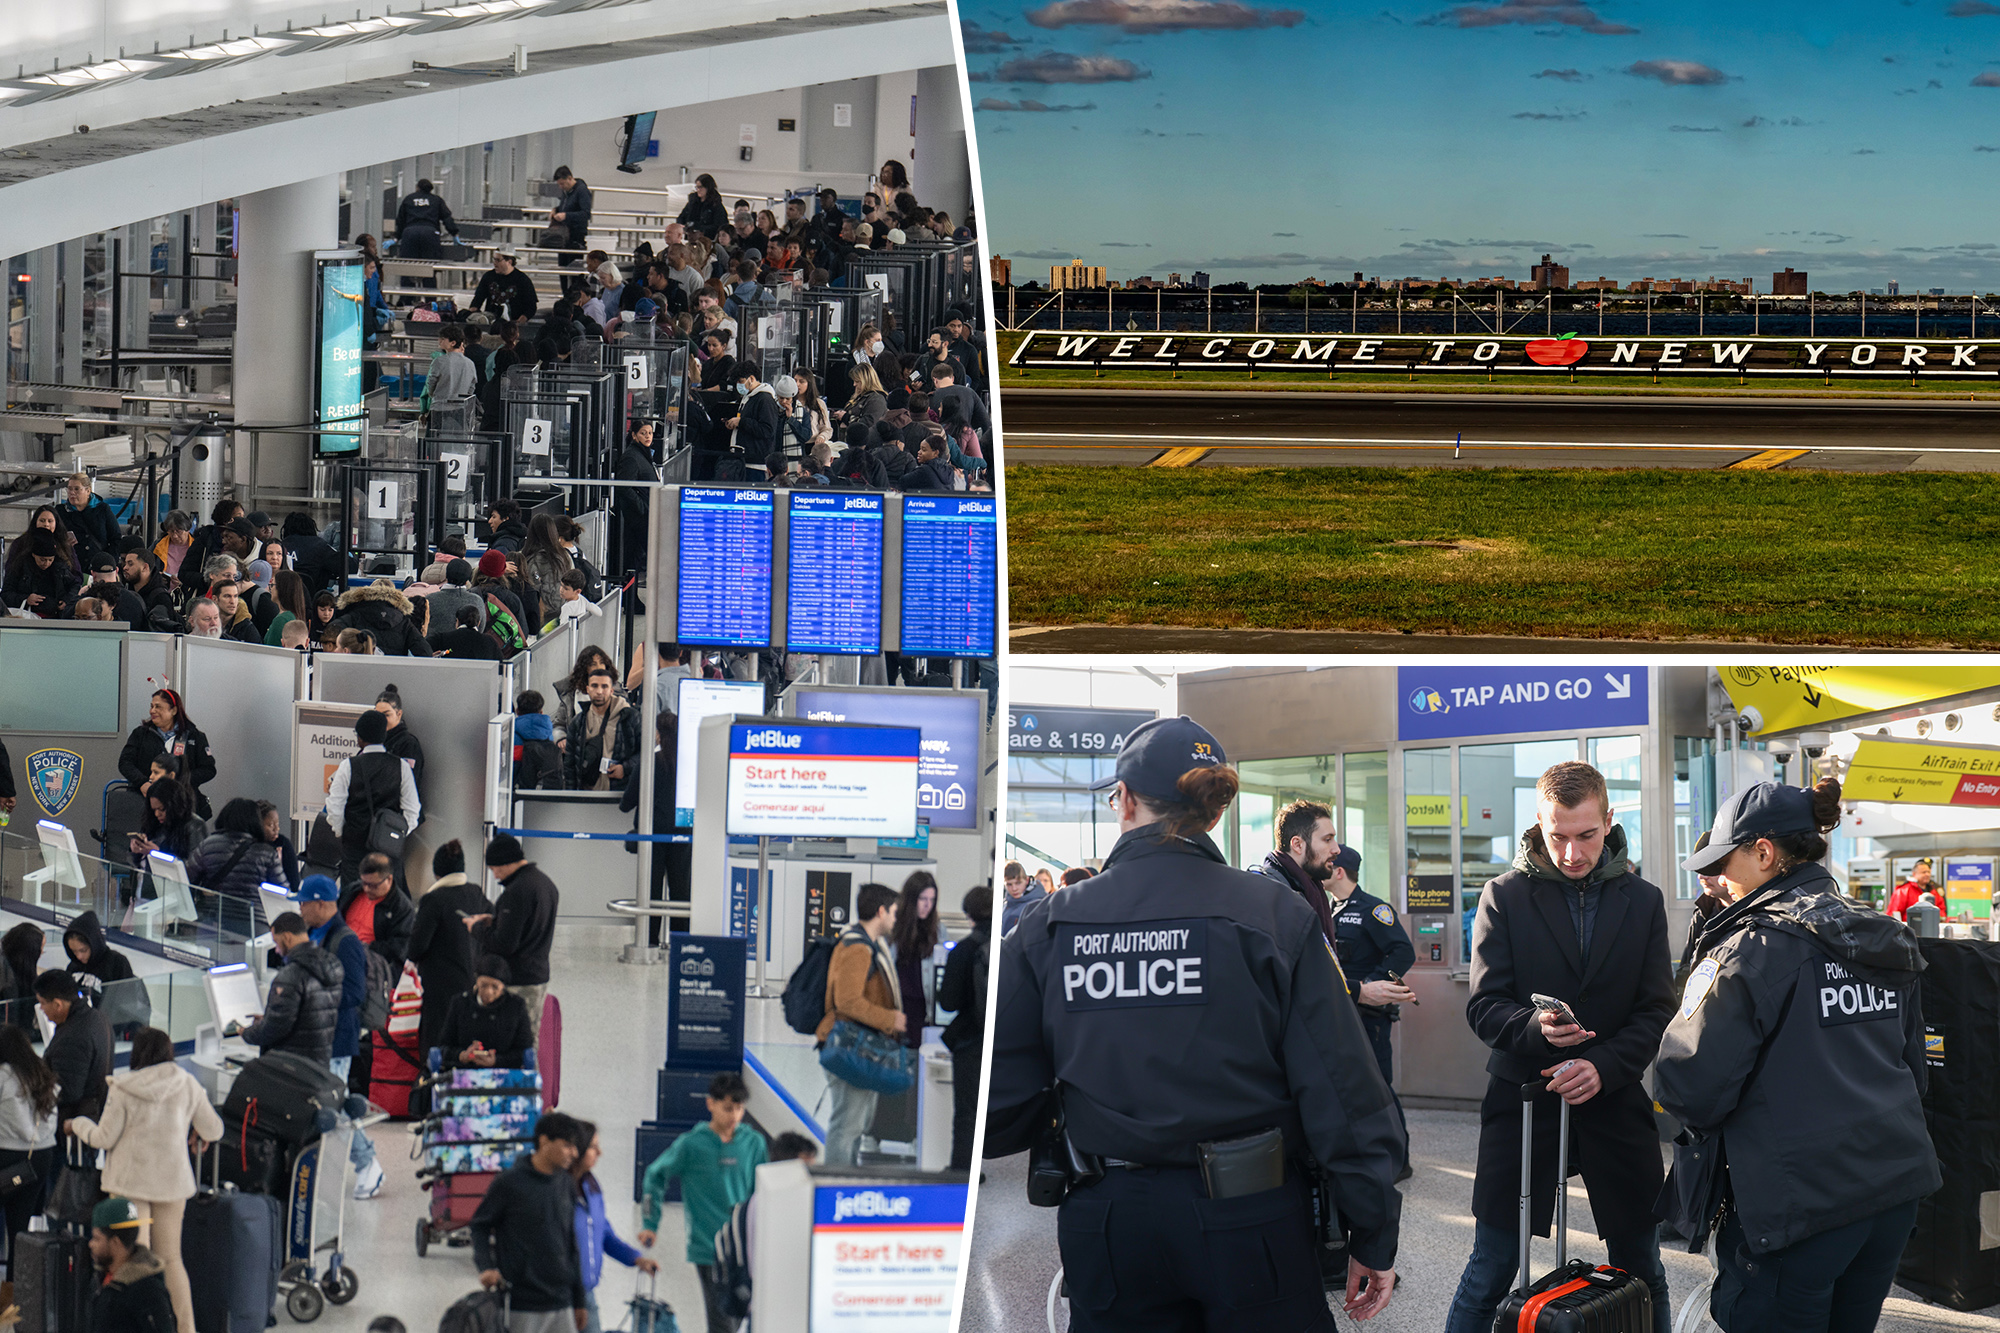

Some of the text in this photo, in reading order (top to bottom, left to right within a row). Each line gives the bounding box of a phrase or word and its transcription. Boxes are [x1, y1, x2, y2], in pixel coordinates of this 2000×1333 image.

[413, 198, 430, 206] TSA
[766, 325, 774, 341] 6
[333, 347, 347, 361] Be
[1057, 336, 1383, 361] WELCOME
[1432, 340, 1499, 362] TO
[1610, 342, 1979, 366] NEW YORK
[631, 362, 641, 380] 5
[532, 425, 542, 444] 3
[448, 459, 459, 479] 2
[378, 486, 387, 508] 1
[684, 488, 725, 497] Departures
[734, 490, 768, 502] jetBlue
[794, 496, 835, 504] Departures
[844, 497, 878, 510] jetBlue
[908, 500, 936, 508] Arrivals
[957, 502, 992, 514] jetBlue
[1769, 666, 1839, 683] Paym
[1450, 677, 1592, 708] TAP AND GO
[311, 733, 361, 748] Addition
[745, 730, 801, 750] jetBlue
[918, 740, 950, 754] way.
[1048, 731, 1063, 748] &
[1069, 732, 1105, 749] 159
[323, 748, 353, 760] Lanes
[1194, 742, 1211, 755] 37
[31, 751, 79, 762] PORT AUTHORITY
[33, 757, 77, 771] POLICE
[1921, 755, 1967, 771] AirTrain
[1970, 759, 1994, 772] Exit
[746, 766, 827, 781] Start here
[1878, 775, 1944, 787] Contactless Payment
[31, 776, 50, 808] NEW YORK
[56, 774, 79, 811] NEW JERSEY
[1961, 782, 2000, 796] No Entry
[744, 801, 798, 812] Comenzar
[1408, 889, 1451, 898] Help phone
[1339, 916, 1362, 925] POLICE
[1074, 929, 1190, 956] PORT AUTHORITY
[1063, 957, 1203, 1002] POLICE
[1820, 983, 1897, 1018] POLICE
[833, 1190, 911, 1222] jetBlue
[835, 1240, 945, 1262] Start here
